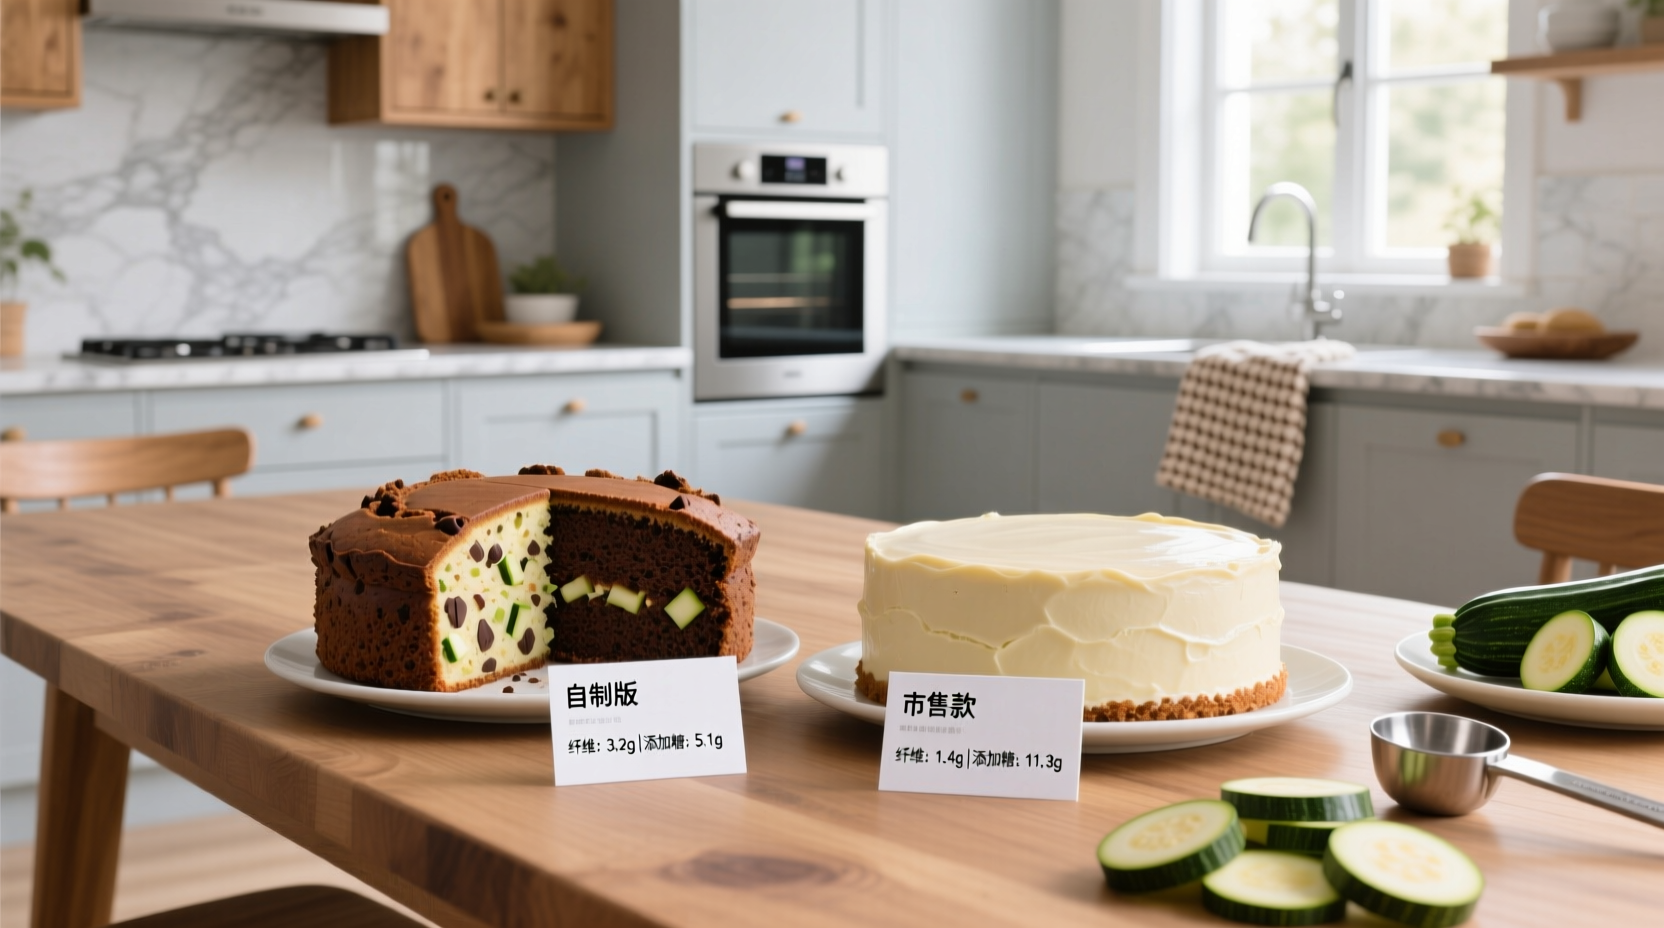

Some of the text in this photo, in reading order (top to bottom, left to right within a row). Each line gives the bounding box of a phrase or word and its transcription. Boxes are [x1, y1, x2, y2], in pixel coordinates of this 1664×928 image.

[567, 680, 639, 709] 自制版
[903, 691, 977, 719] 市售款
